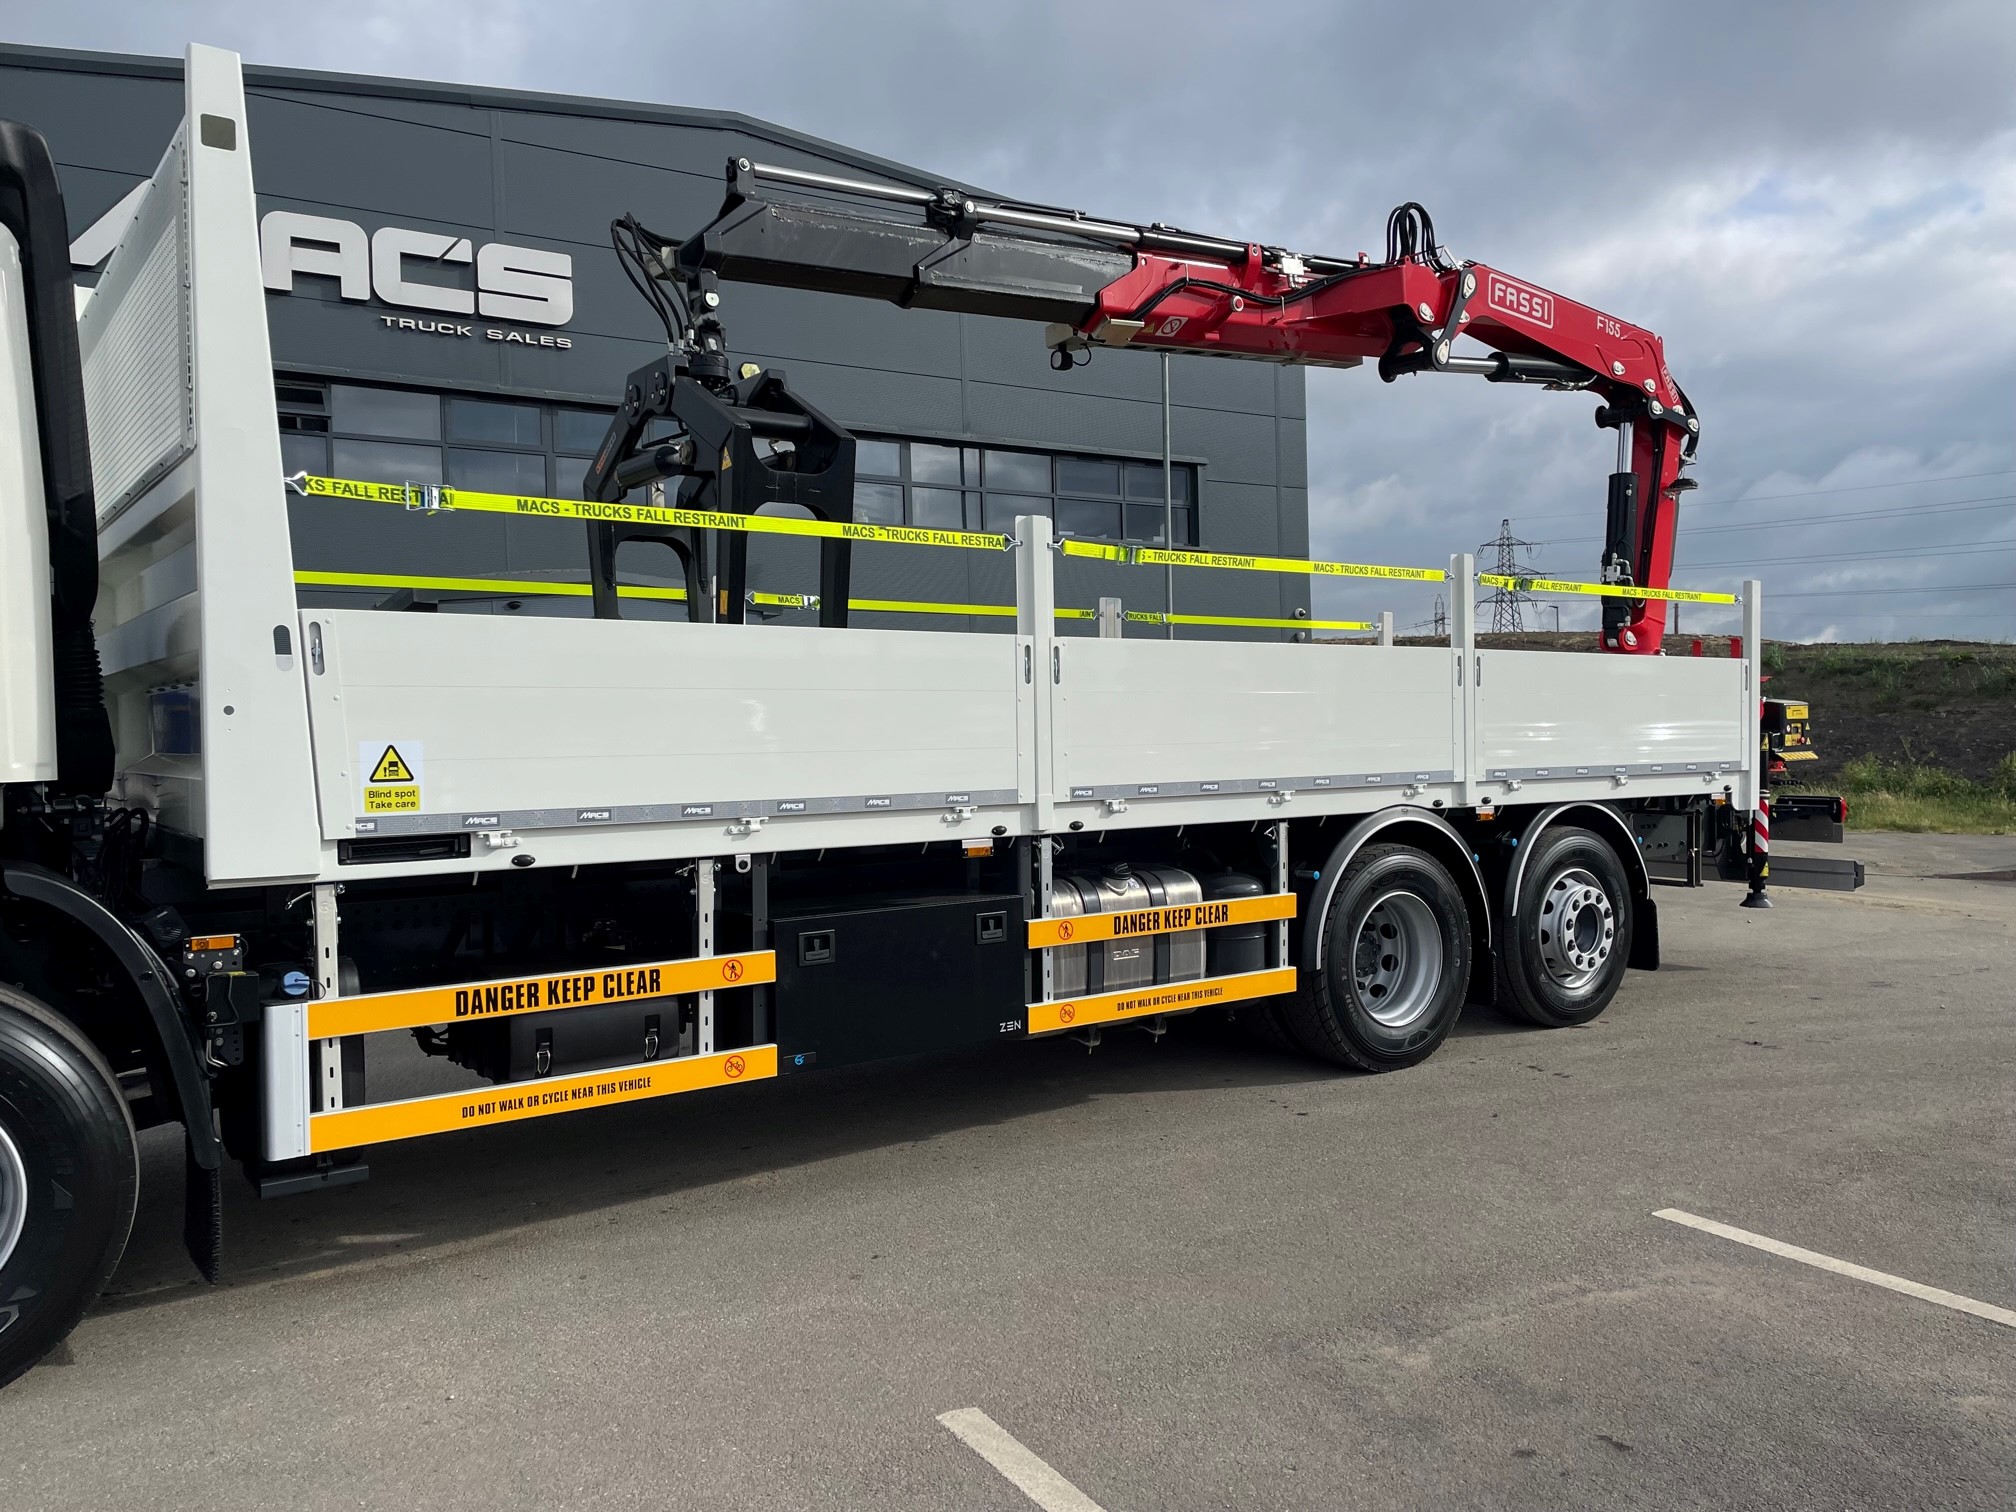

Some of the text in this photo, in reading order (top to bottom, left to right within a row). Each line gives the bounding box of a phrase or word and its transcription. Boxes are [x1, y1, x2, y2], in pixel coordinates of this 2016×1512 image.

[1494, 282, 1549, 320] FASSI
[380, 315, 573, 349] TRUCK SALES
[1596, 315, 1622, 338] F155
[332, 481, 374, 499] FALL
[516, 498, 560, 515] MACS
[572, 502, 632, 520] TRUCKS
[636, 507, 671, 523] FALL
[673, 511, 748, 529] RESTRAINT
[842, 525, 876, 539] MACS
[886, 527, 929, 543] TRUCKS
[932, 531, 959, 545] FALL
[961, 534, 1005, 549] RESTRAI
[1152, 551, 1187, 563] TRUCKS
[1189, 554, 1210, 565] FALL
[1211, 555, 1256, 568] RESTRAINT
[1313, 562, 1335, 573] MACS
[1340, 564, 1369, 576] TRUCKS
[1370, 566, 1388, 577] FALL
[1388, 568, 1426, 579] RESTRAINT
[1481, 575, 1499, 586] MACS
[1535, 581, 1582, 592] FALL RESTRAINT
[777, 595, 801, 605] MACS
[1622, 588, 1637, 596] MACS
[1641, 589, 1661, 598] TRUCKS
[1661, 590, 1674, 599] FALL
[1674, 591, 1702, 600] RESTRAINT
[368, 789, 416, 800] Blind spot
[947, 794, 970, 803] MACS
[368, 800, 393, 809] Take
[778, 802, 805, 811] MACS
[866, 798, 891, 807] MACS
[579, 810, 610, 820] MACS
[683, 805, 712, 815] MACS
[464, 815, 498, 825] MACS
[1113, 904, 1229, 935] DANGER KEEP CLEAR
[455, 968, 661, 1017] DANGER KEEP CLEAR
[1116, 987, 1223, 1012] DO NOT WALK OR CYCLE NEAR THIS VEHICLE
[999, 1019, 1022, 1033] ZEN
[461, 1076, 652, 1119] DO NOT WALK OR CYCLE NEAR THIS VEHICLE
